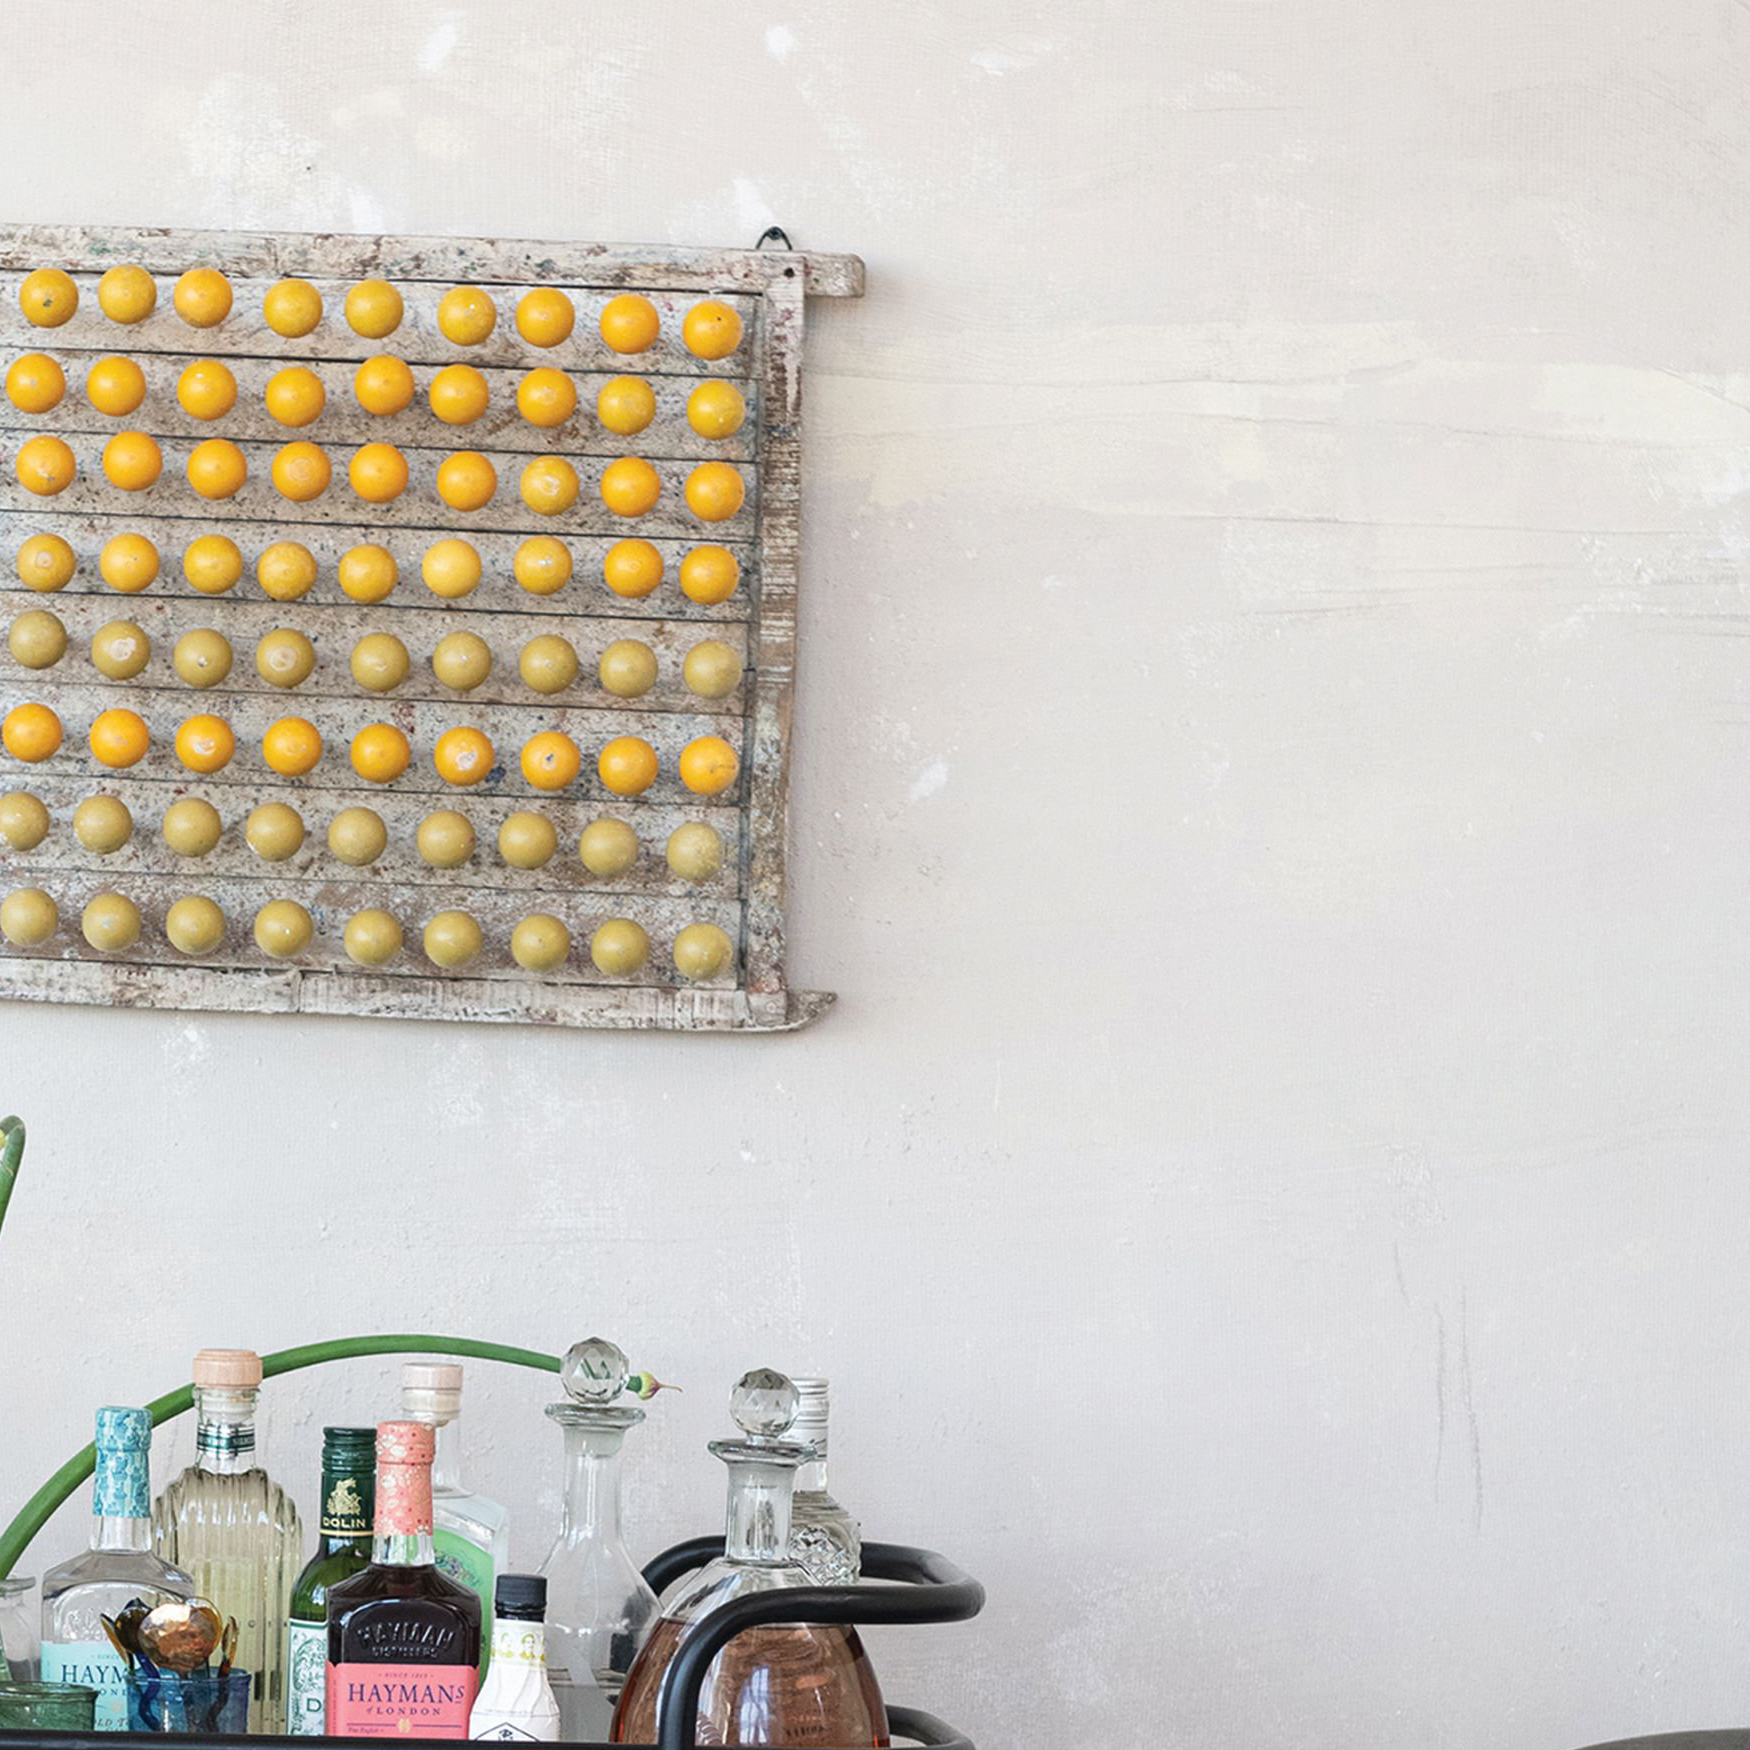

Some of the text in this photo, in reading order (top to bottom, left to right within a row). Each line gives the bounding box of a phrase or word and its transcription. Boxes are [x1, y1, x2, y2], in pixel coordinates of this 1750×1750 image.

[323, 1517, 366, 1528] DOLIN
[61, 1664, 128, 1685] HAYM
[376, 1706, 442, 1716] LONDON
